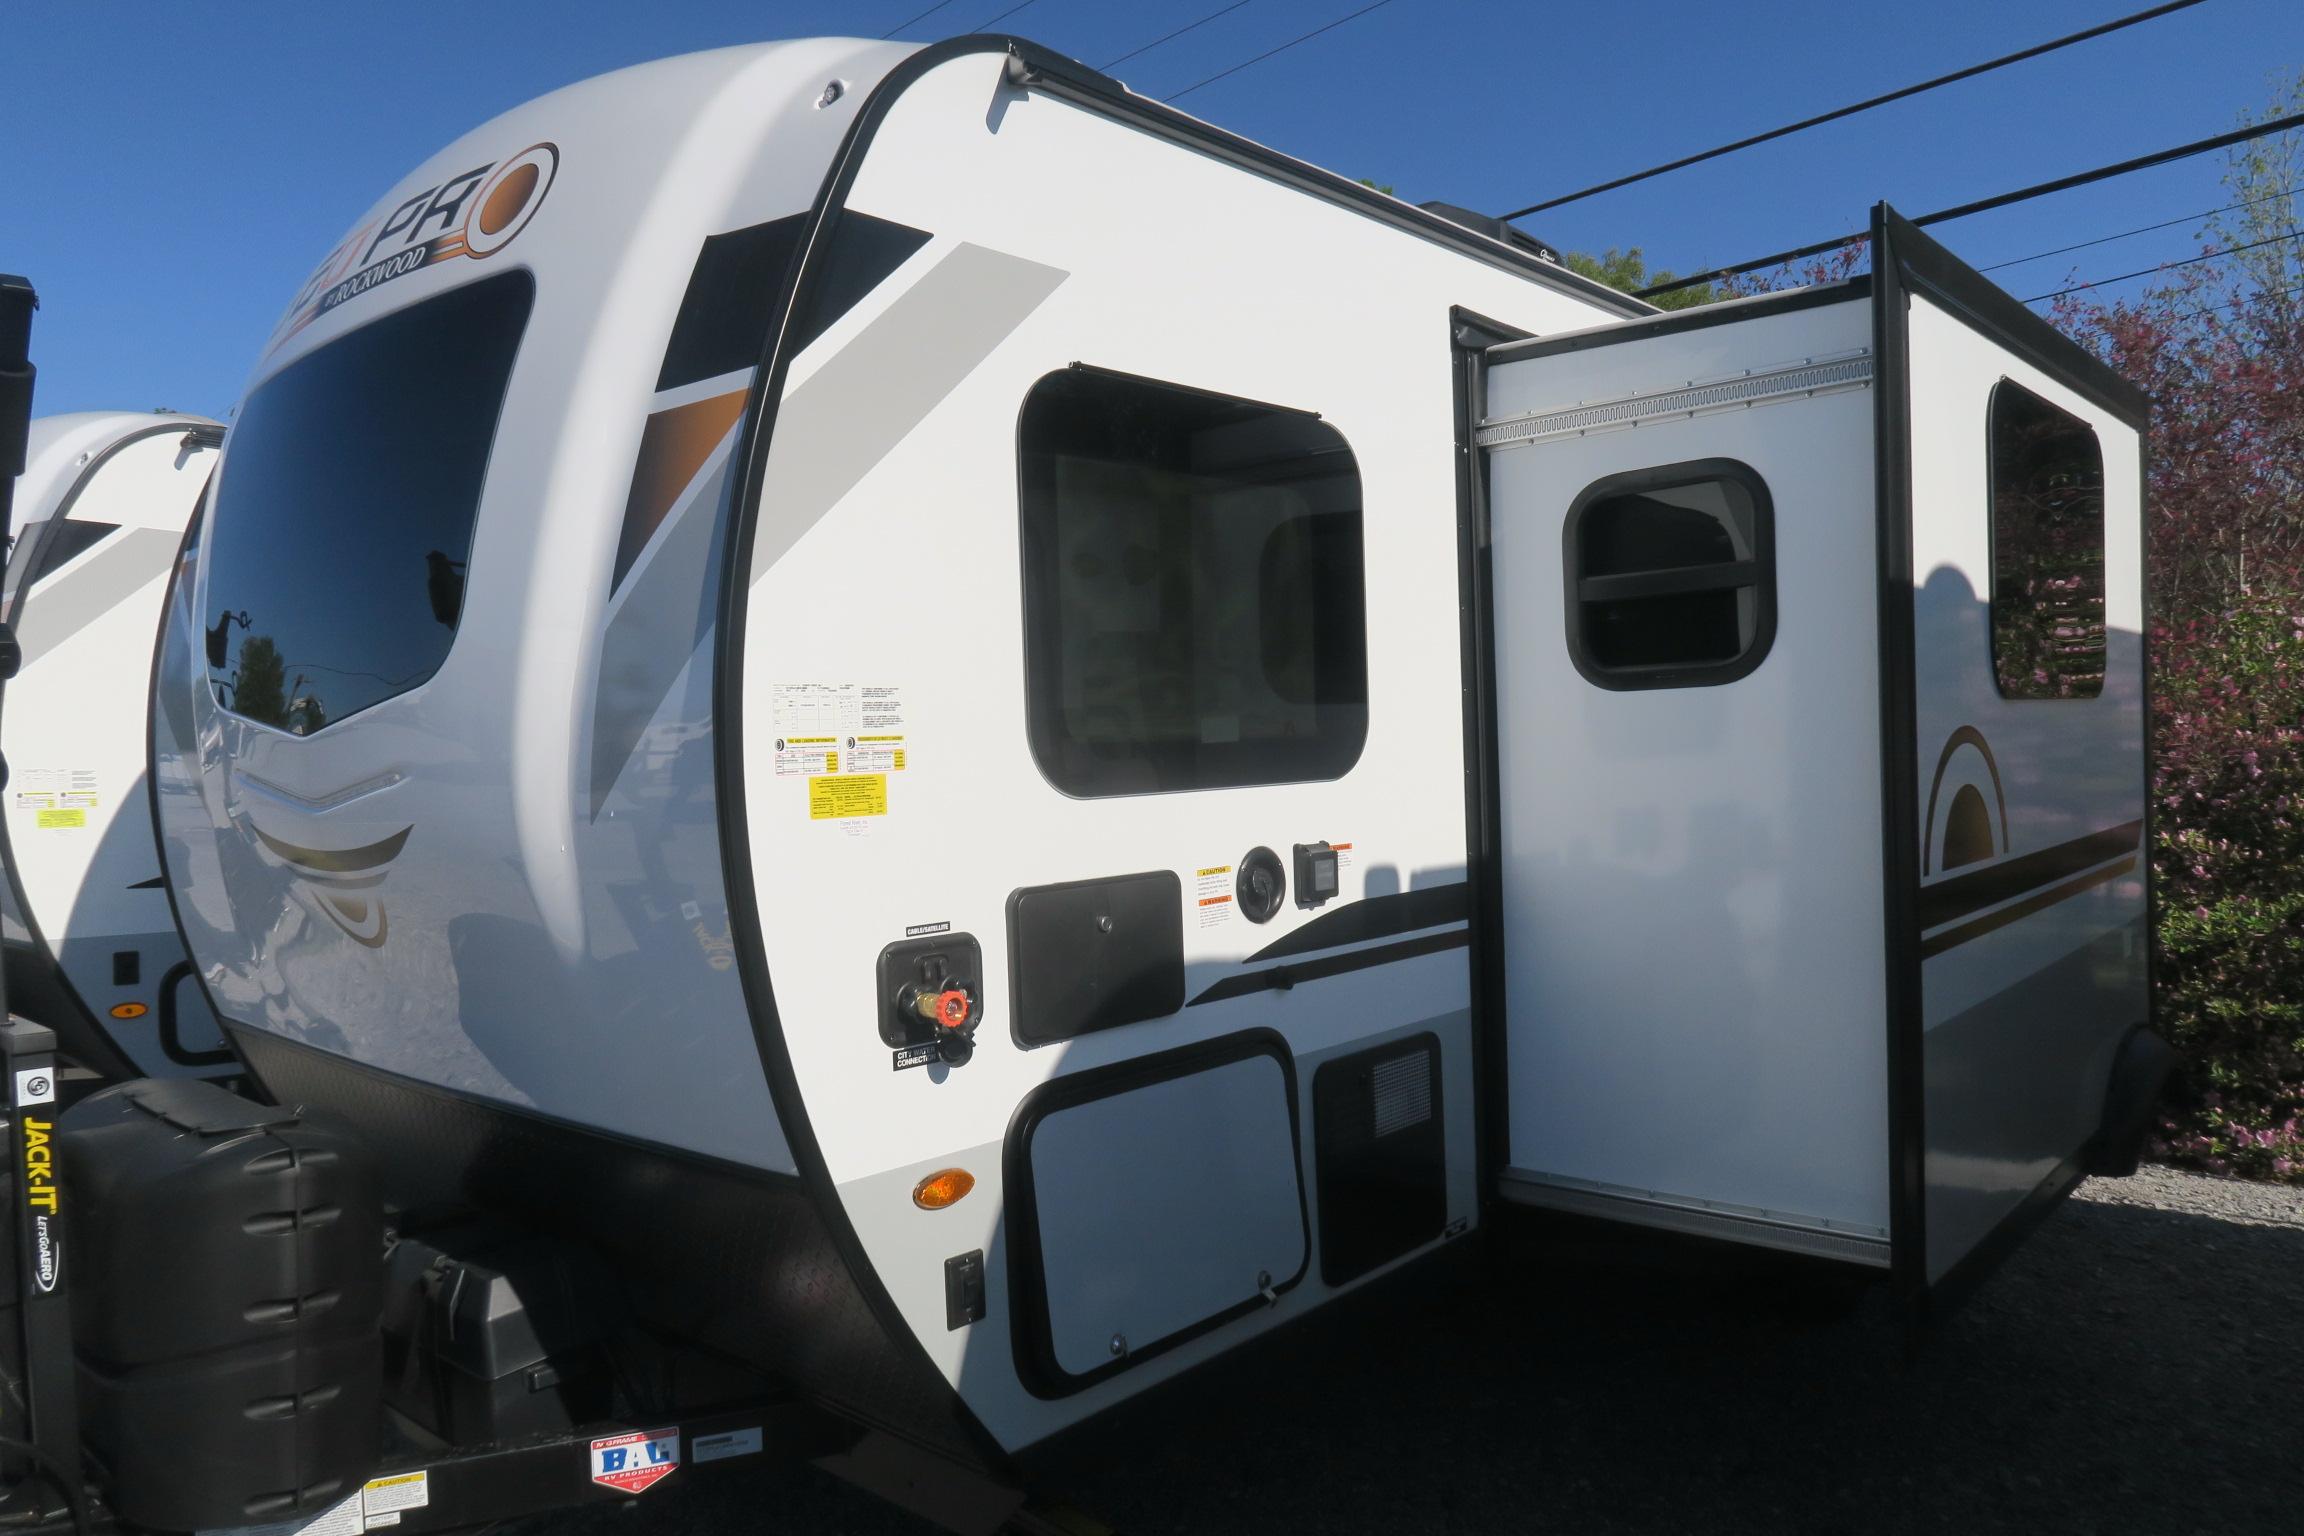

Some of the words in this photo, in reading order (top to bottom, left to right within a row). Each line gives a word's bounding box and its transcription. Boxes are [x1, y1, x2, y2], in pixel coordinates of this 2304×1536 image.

[333, 246, 426, 306] ROCKWOOD
[1206, 867, 1226, 875] CAUTION
[1208, 896, 1229, 904] WARNING
[908, 923, 949, 936] CABLE/SATELLITE
[897, 1049, 912, 1060] CITY
[913, 1046, 936, 1057] WATER
[897, 1053, 937, 1067] CONNECTION
[25, 1117, 57, 1213] JACK-IT
[601, 1441, 670, 1473] BAL
[604, 1474, 617, 1482] RV
[619, 1465, 668, 1479] PRODUCTS
[384, 1476, 412, 1486] CAUTION
